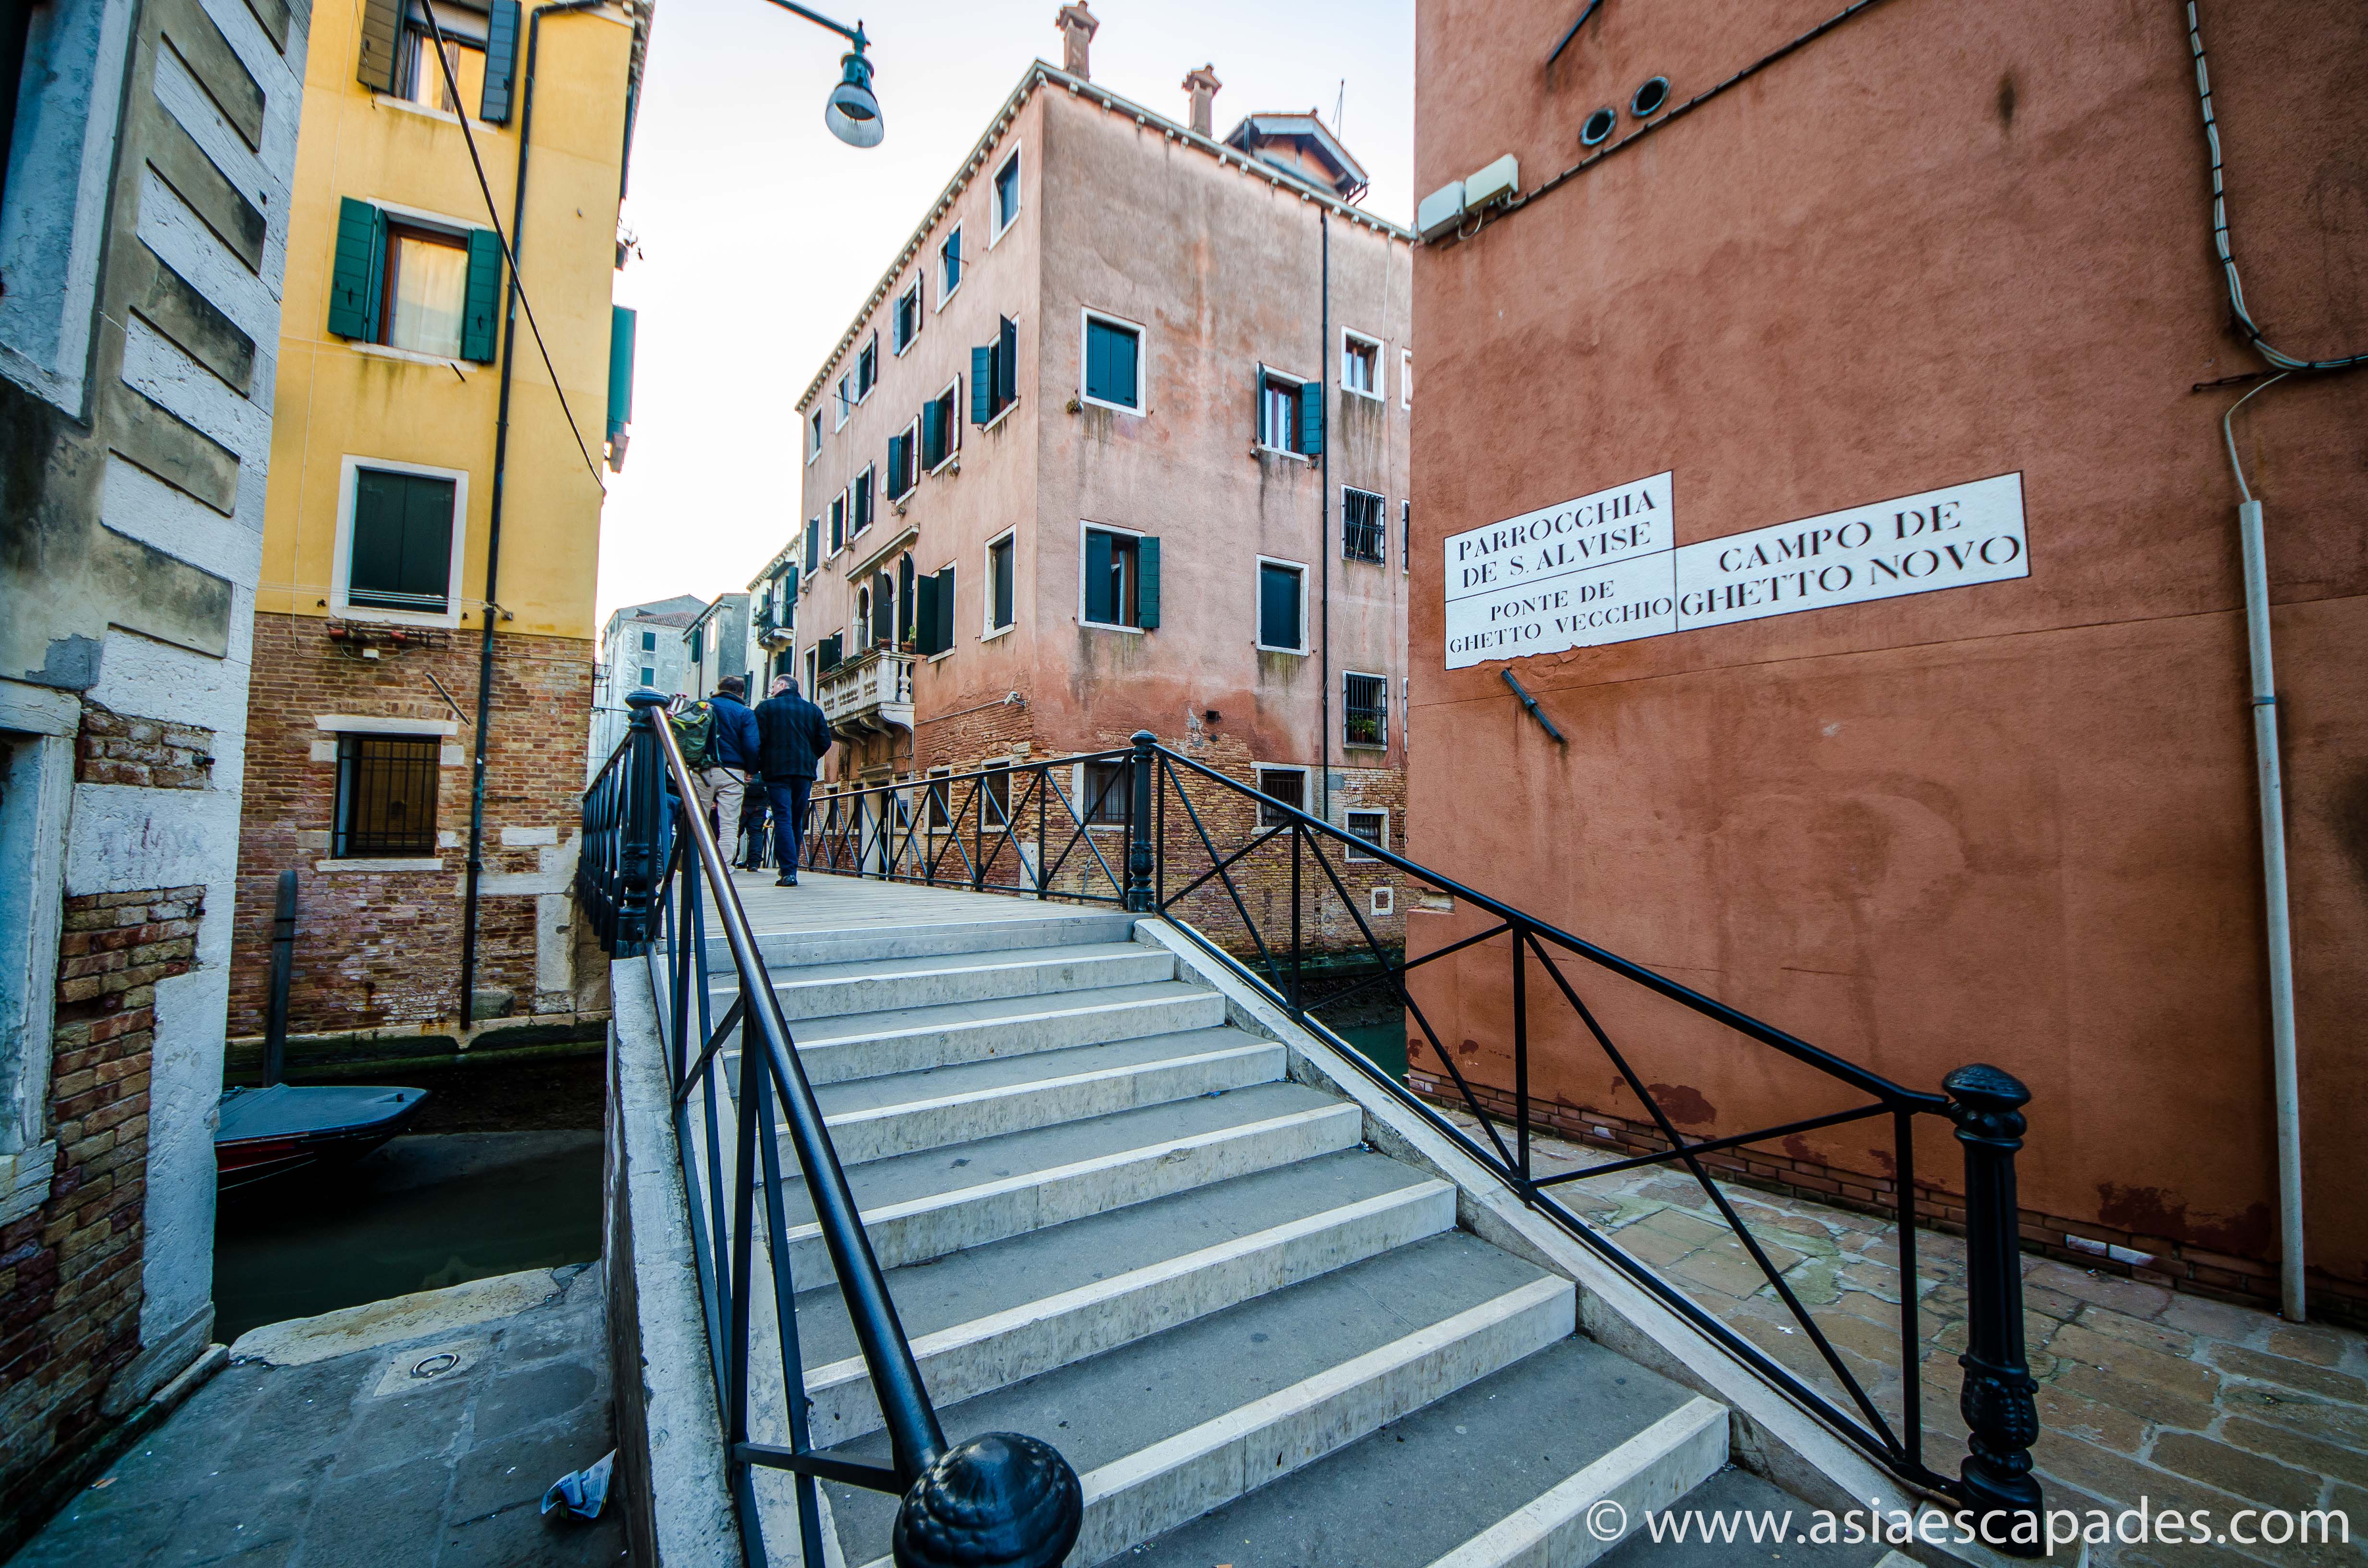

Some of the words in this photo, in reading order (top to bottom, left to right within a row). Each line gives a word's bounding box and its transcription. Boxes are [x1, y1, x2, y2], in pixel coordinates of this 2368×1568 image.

[1459, 490, 1656, 562] PARROCCHIA
[1719, 522, 1872, 573] CAMPO
[1895, 501, 1961, 540] DE
[1463, 562, 1498, 588] DE
[1491, 590, 1568, 622] PONTE
[1581, 580, 1615, 603] DE
[1680, 565, 1853, 616] GHETTO
[1870, 536, 2021, 586] NOVO
[1450, 624, 1542, 653] GHETTO
[1555, 598, 1672, 635] VECCHIO
